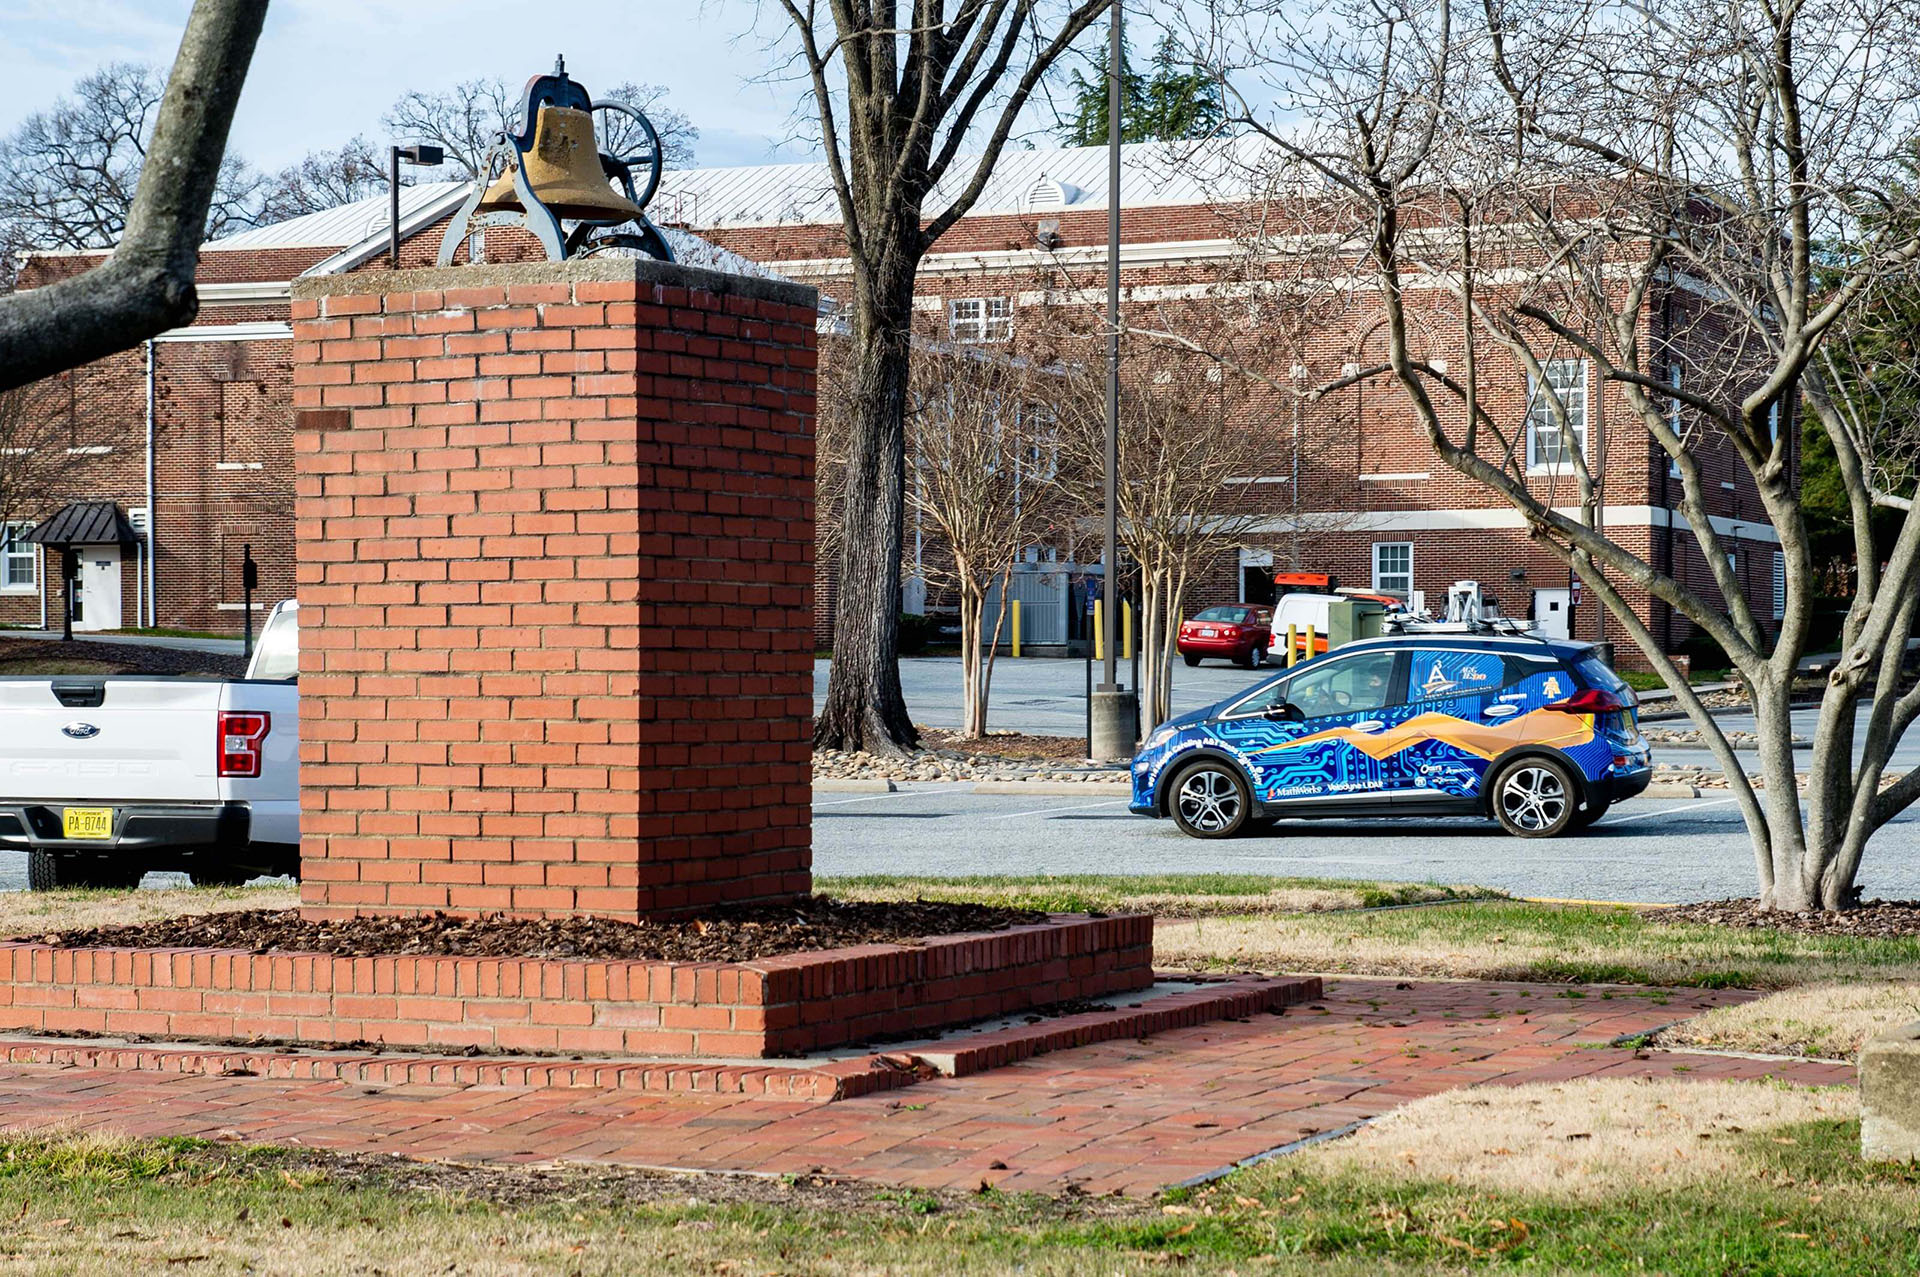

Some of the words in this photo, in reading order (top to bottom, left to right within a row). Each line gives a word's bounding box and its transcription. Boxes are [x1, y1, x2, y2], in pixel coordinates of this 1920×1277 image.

[1219, 740, 1239, 755] State
[1277, 785, 1323, 796] MathWorks
[1327, 782, 1363, 792] Velodyne
[69, 816, 106, 831] PA-8744
